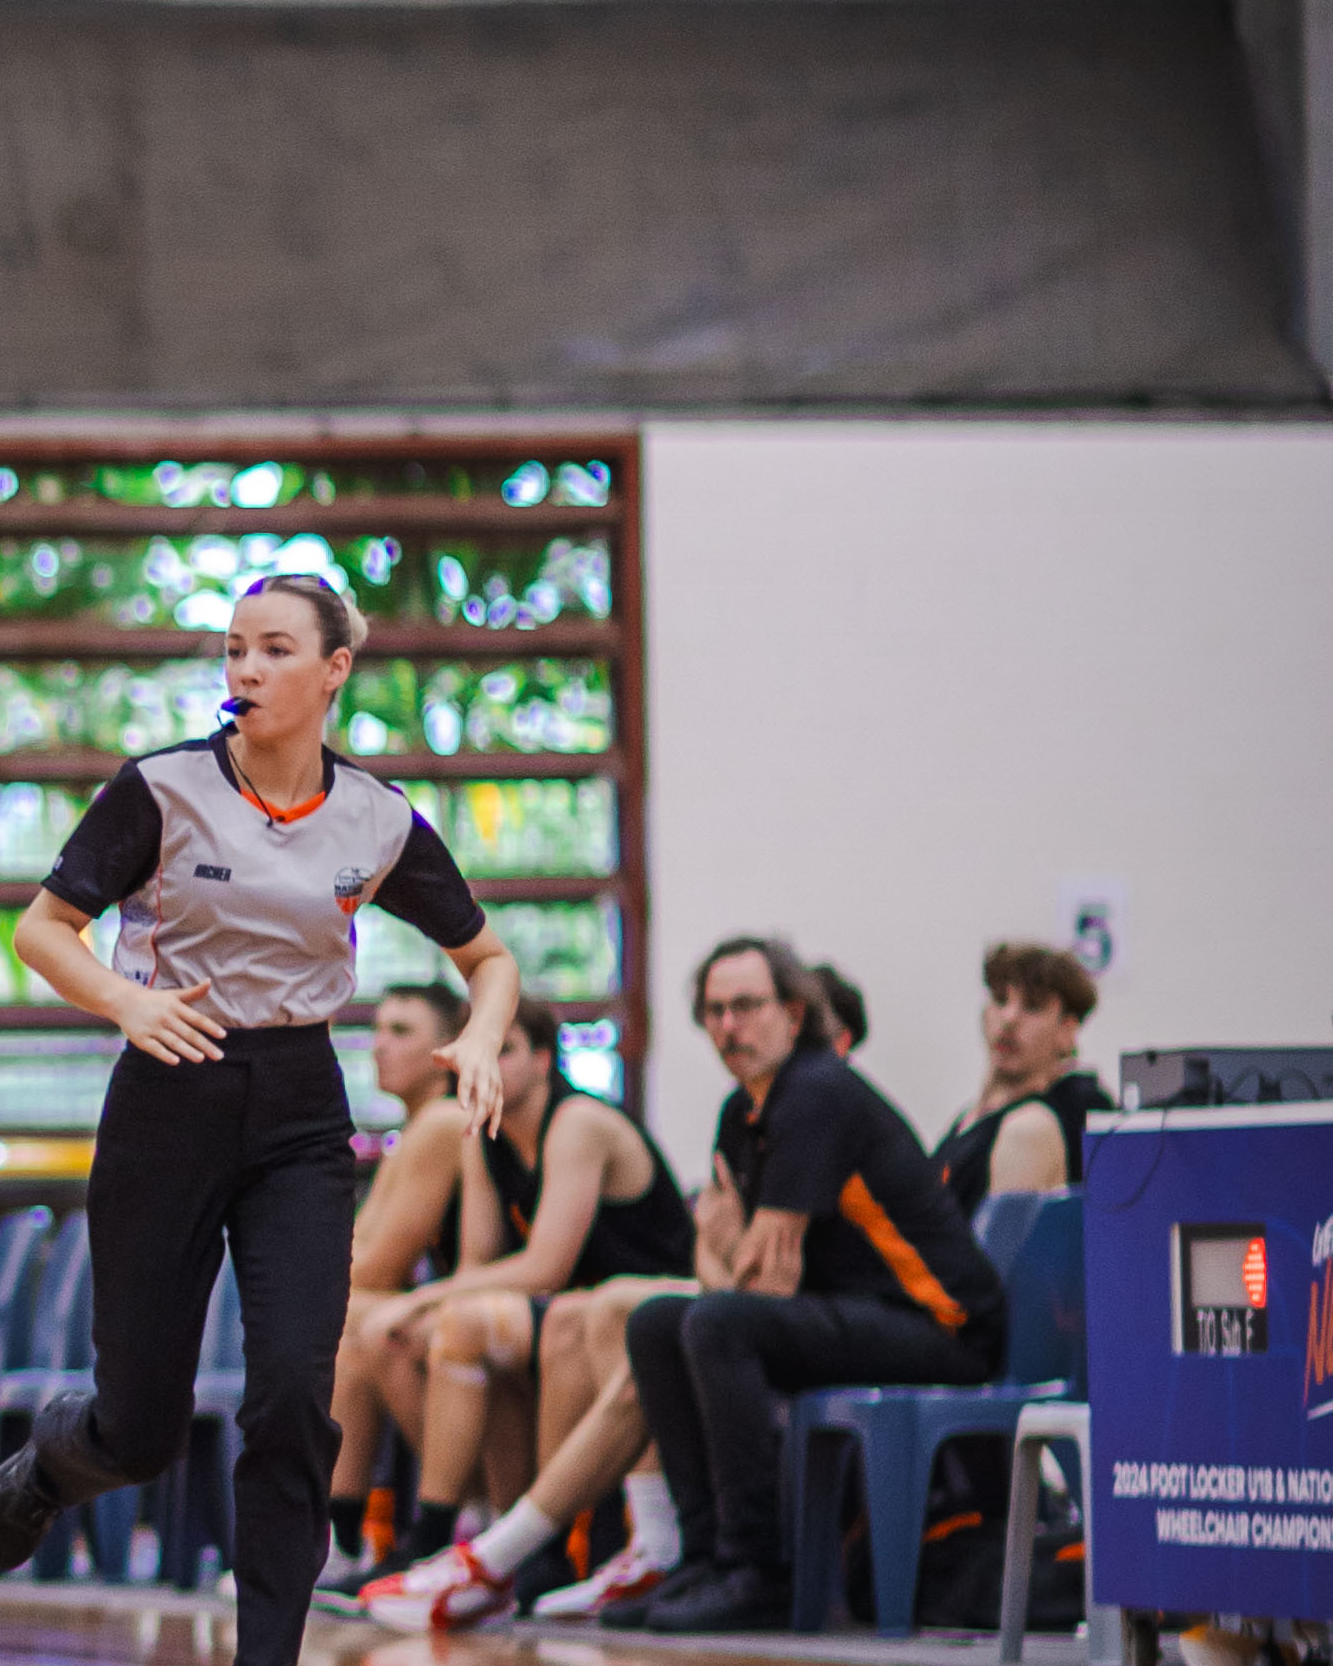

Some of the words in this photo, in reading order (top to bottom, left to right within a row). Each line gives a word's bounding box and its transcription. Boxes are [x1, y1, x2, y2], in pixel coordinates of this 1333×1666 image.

[1075, 903, 1112, 972] 5
[1113, 1461, 1148, 1498] 2024
[1150, 1462, 1187, 1500] FOOT
[1189, 1464, 1245, 1501] LOCKER
[1275, 1467, 1285, 1503] &
[1157, 1508, 1249, 1546] WHEELCHAIR
[1252, 1513, 1333, 1550] CHAMPION
